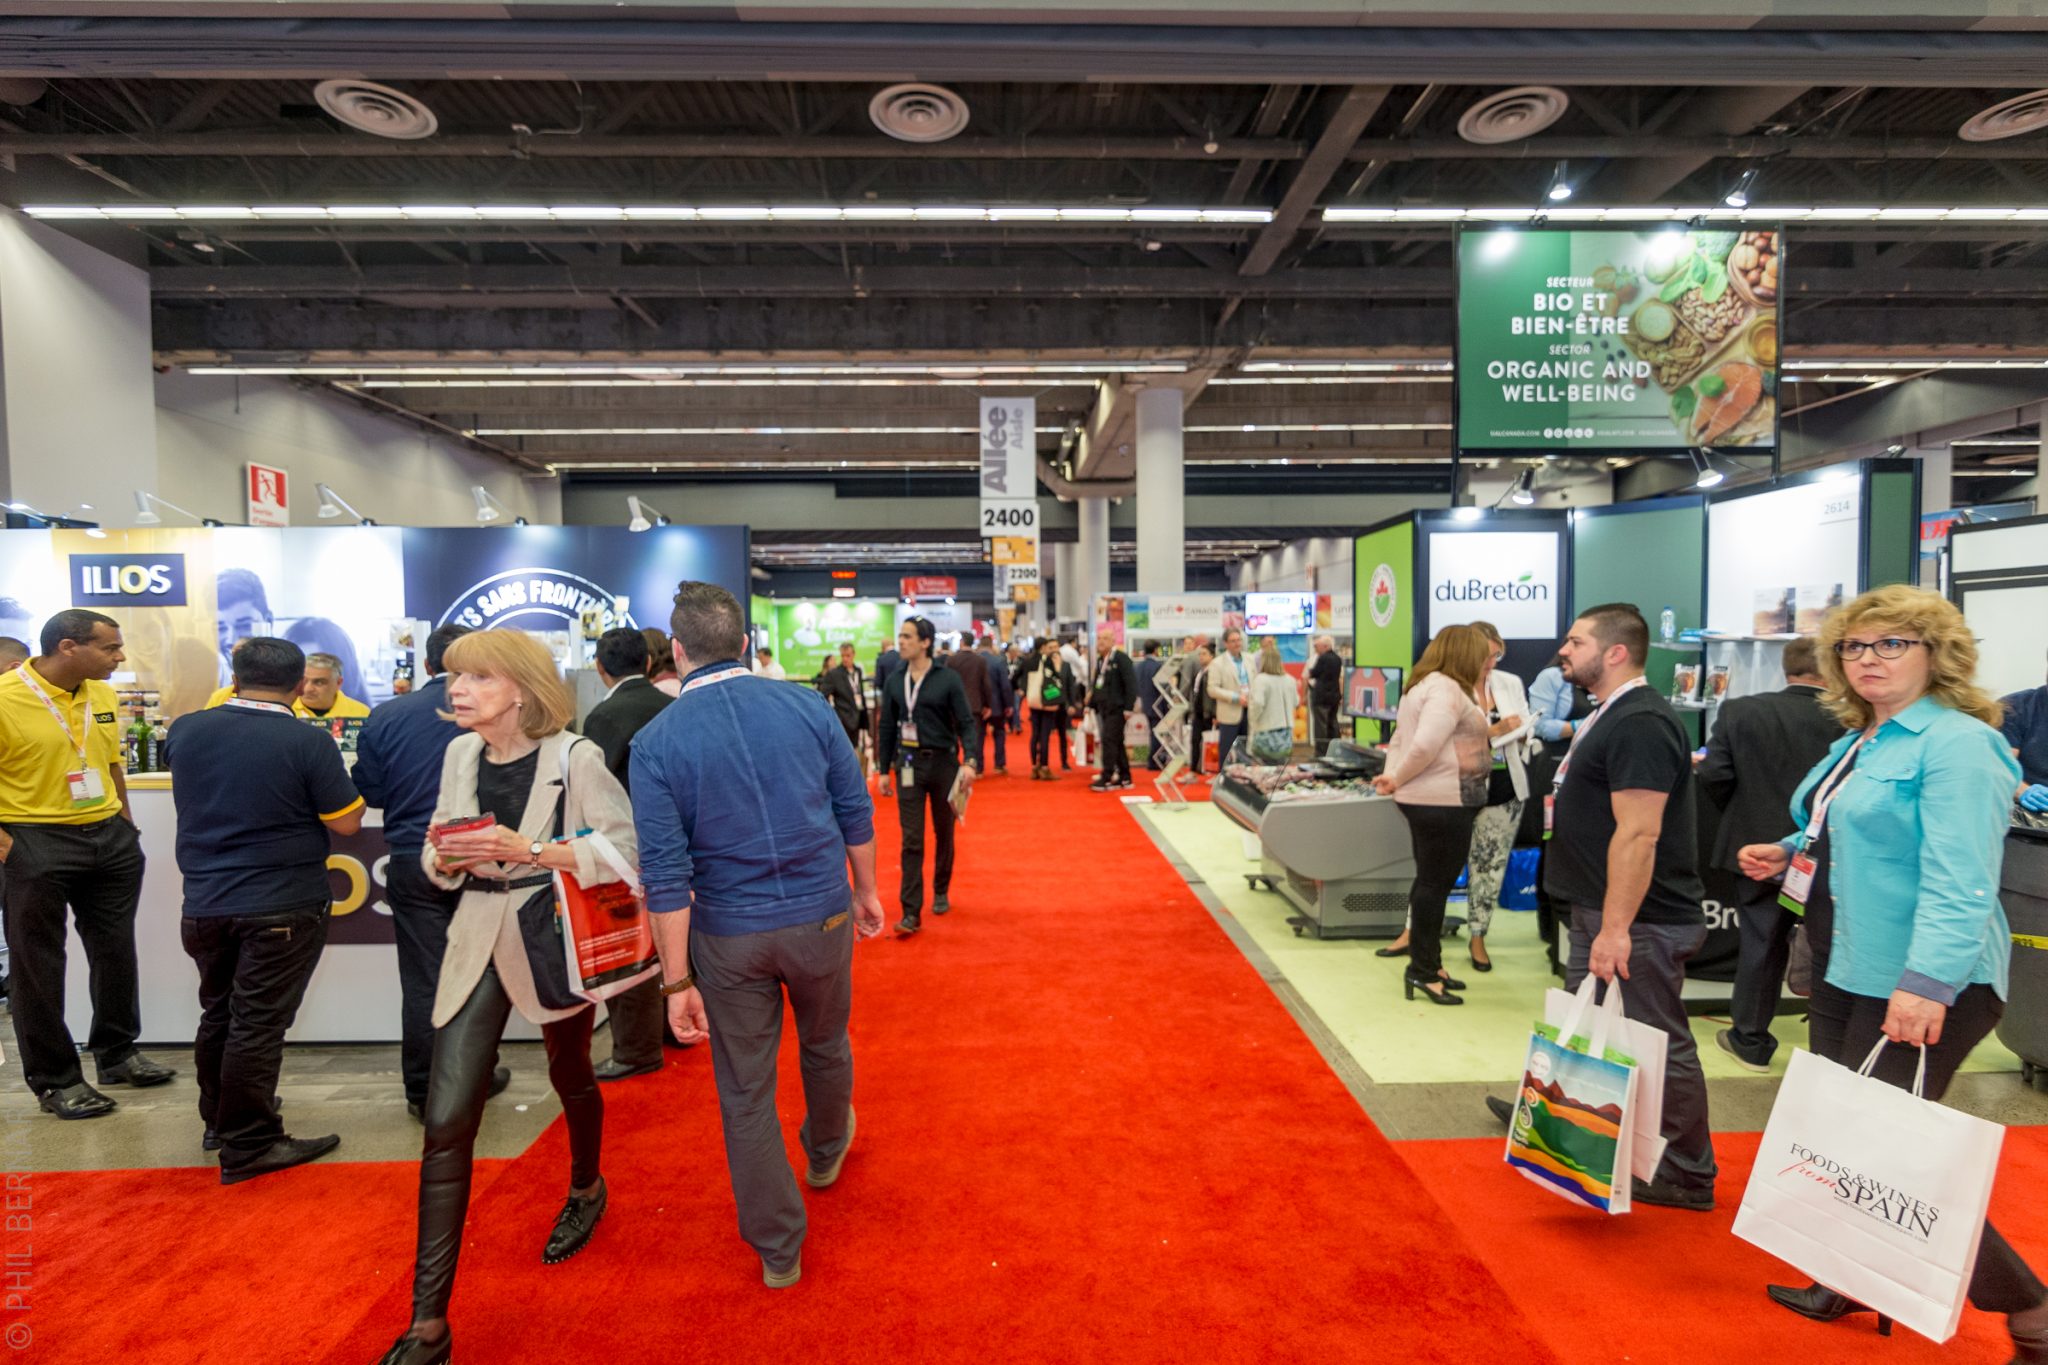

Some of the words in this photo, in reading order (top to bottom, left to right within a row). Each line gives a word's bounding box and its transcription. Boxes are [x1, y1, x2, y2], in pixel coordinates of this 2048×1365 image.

[1546, 277, 1595, 288] SECTEUR
[1533, 293, 1574, 311] BIO
[1582, 293, 1608, 311] ET
[1511, 313, 1630, 335] BIEN-ÊTRE
[1549, 344, 1591, 355] SECTOR
[1487, 361, 1595, 379] ORGANIC
[1602, 361, 1651, 379] AND
[1502, 384, 1636, 402] WELL-BEING
[1010, 408, 1024, 449] Aisle
[983, 406, 1008, 494] Allée
[1824, 500, 1851, 515] 2614
[984, 509, 1034, 526] 2400
[82, 564, 172, 594] ILIOS
[1010, 568, 1037, 579] 2200
[476, 581, 527, 617] SANS
[1435, 580, 1548, 601] duBreton
[1777, 1159, 1836, 1189] from
[1834, 1177, 1935, 1238] SPAIN
